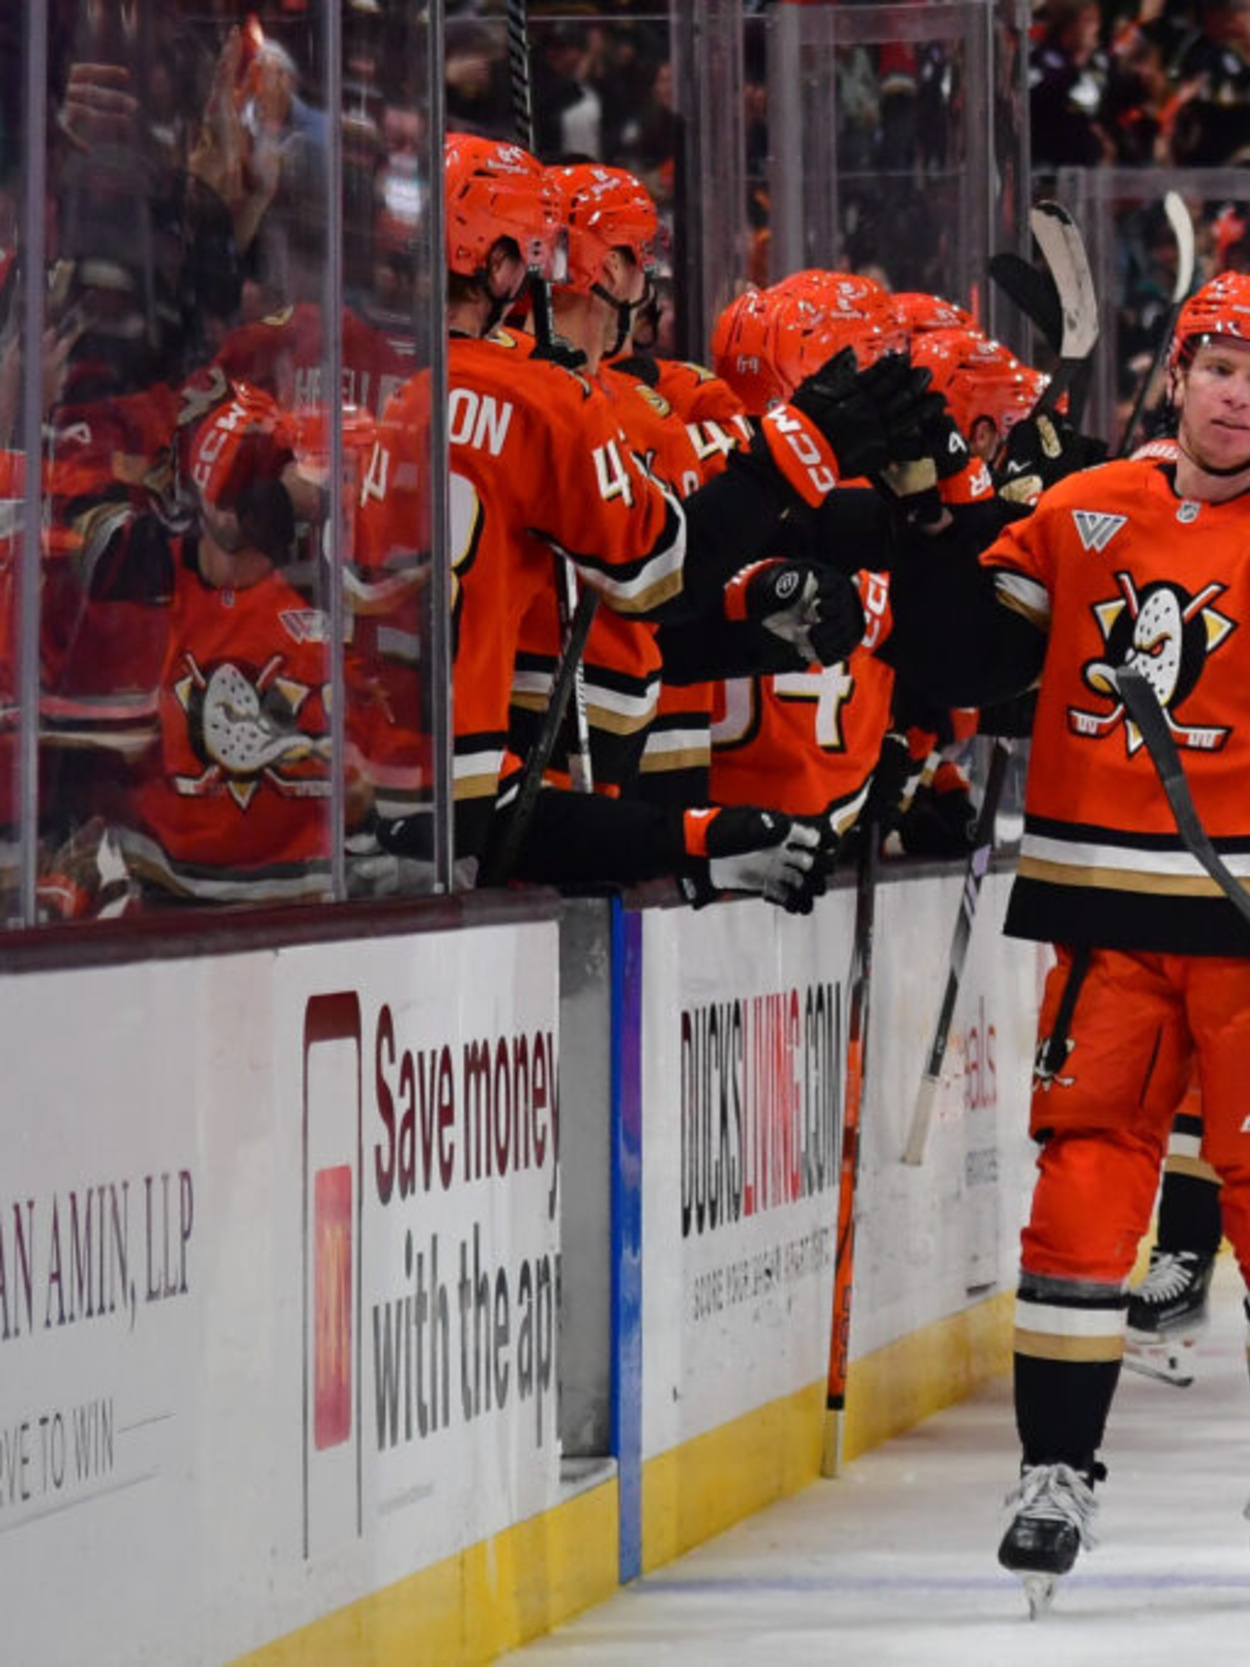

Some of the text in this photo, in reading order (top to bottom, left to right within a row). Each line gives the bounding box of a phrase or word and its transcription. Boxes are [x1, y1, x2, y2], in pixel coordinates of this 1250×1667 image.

[766, 405, 836, 493] CCM
[374, 1003, 560, 1222] Save money
[44, 1179, 136, 1334] AMIN,
[144, 1170, 194, 1302] LLP
[372, 1228, 450, 1453] with
[458, 1221, 510, 1423] the
[0, 1397, 114, 1507] VE TO WIN
